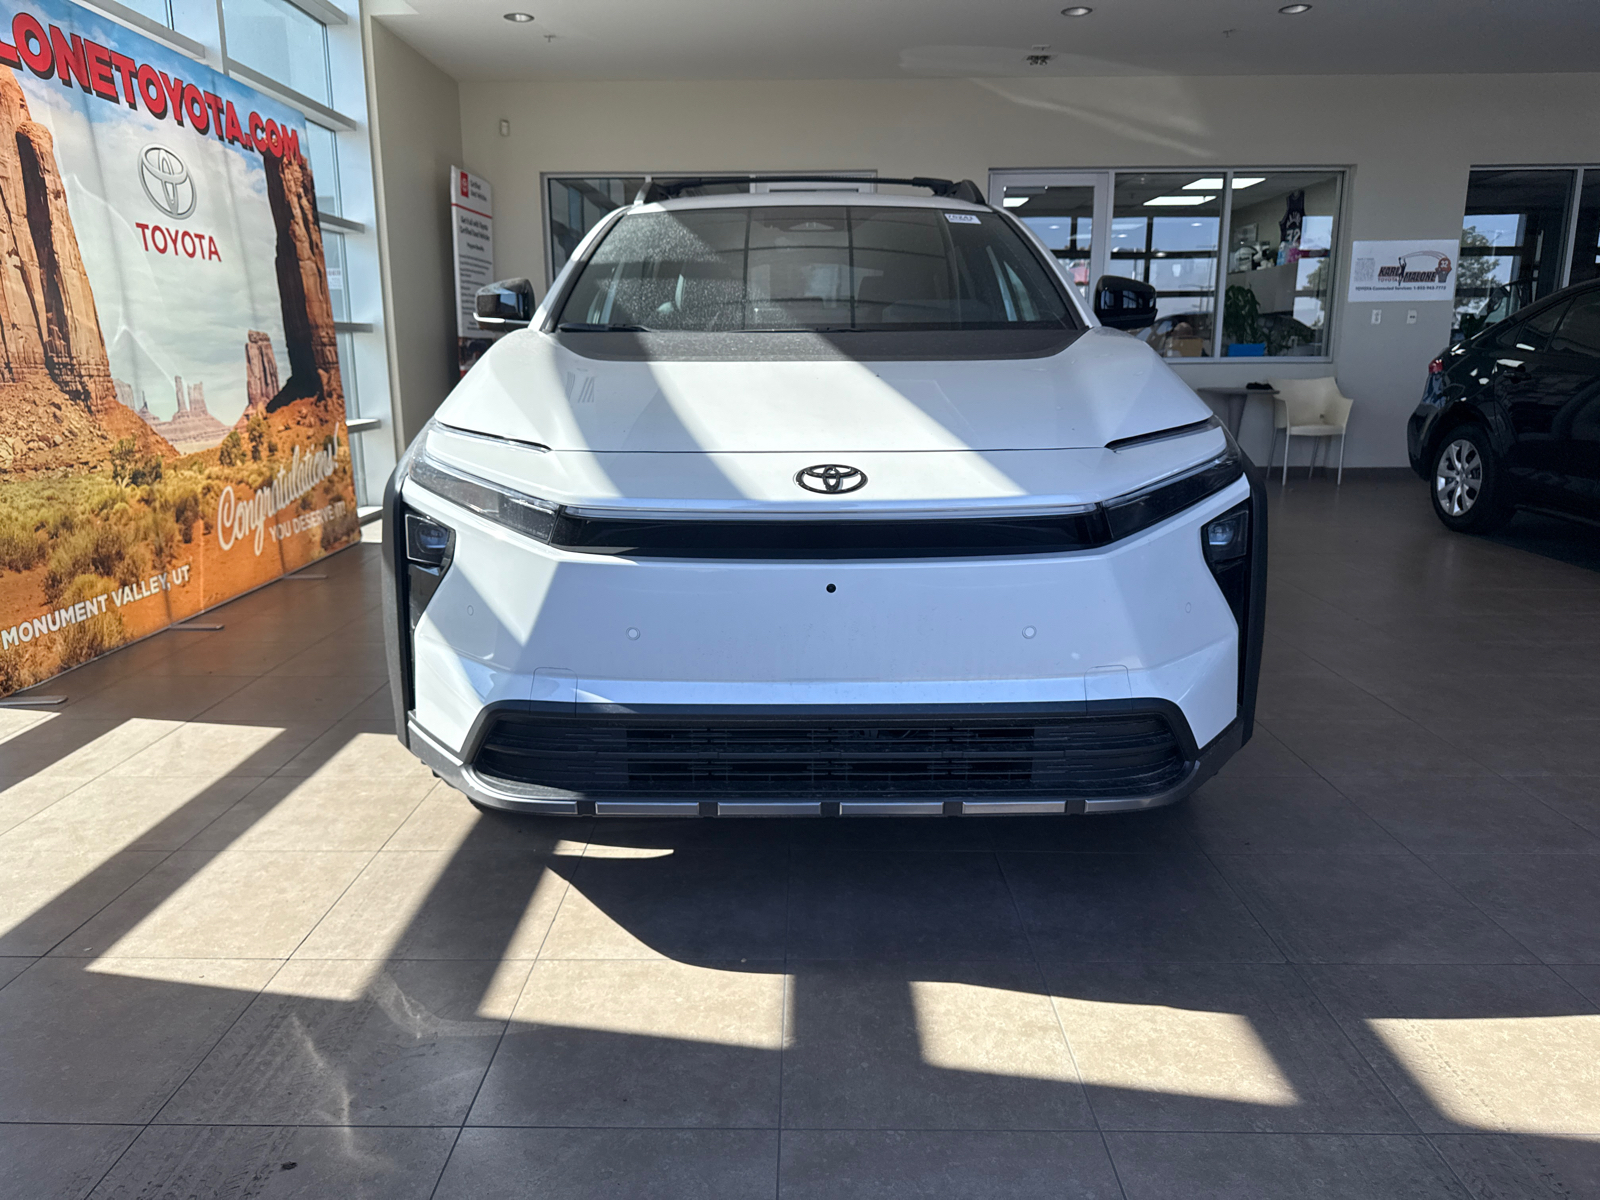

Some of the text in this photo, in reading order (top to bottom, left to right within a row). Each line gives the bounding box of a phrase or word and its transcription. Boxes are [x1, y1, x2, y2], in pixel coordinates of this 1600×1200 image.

[135, 221, 222, 262] TOYOTA
[1378, 266, 1436, 283] KARL MALONE
[269, 520, 292, 542] YOU
[292, 505, 334, 534] DESERVE
[0, 565, 190, 650] MONUMENT VALLEY, UT
